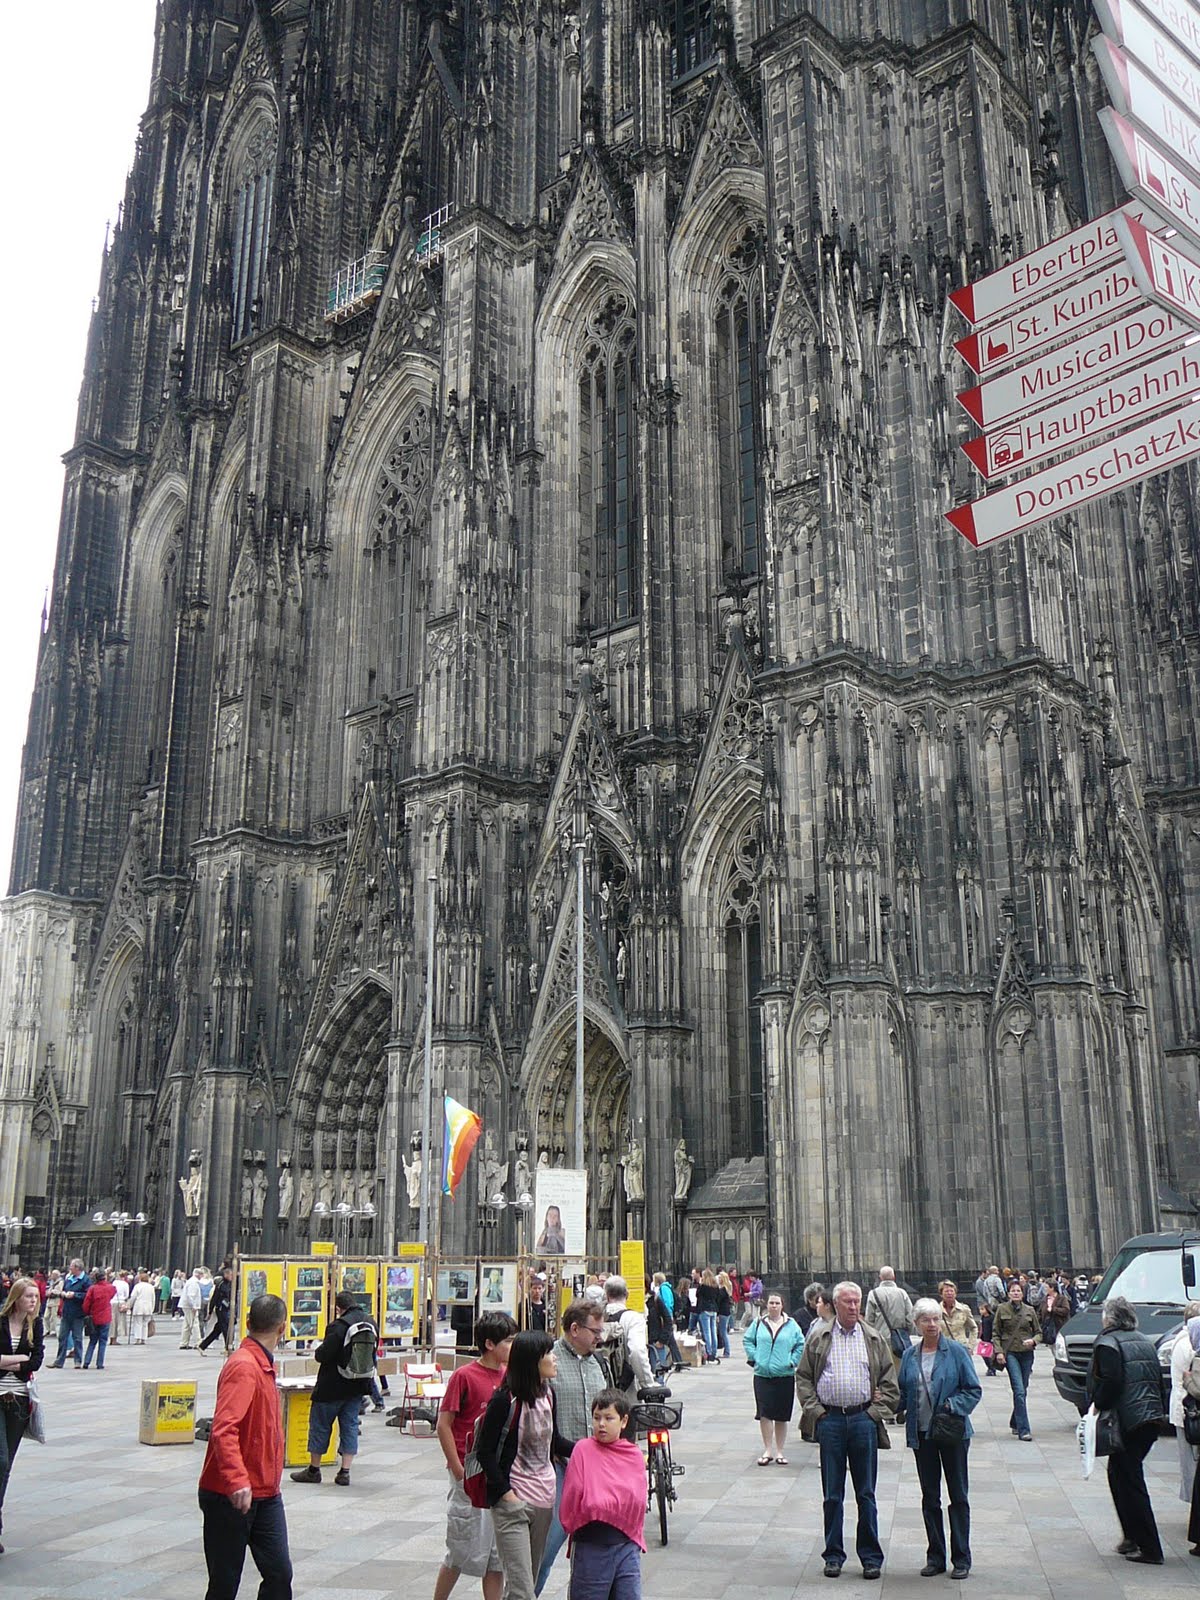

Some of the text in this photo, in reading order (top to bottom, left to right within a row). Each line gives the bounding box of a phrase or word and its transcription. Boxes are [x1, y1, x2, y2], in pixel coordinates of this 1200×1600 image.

[1152, 0, 1200, 50] tadt
[1162, 103, 1200, 163] IHK
[1170, 176, 1199, 225] St.
[1012, 212, 1144, 294] Ebertpla
[1016, 315, 1049, 344] St.
[1026, 356, 1200, 450] Hauptbahnh
[1014, 419, 1200, 517] Domschatzk
